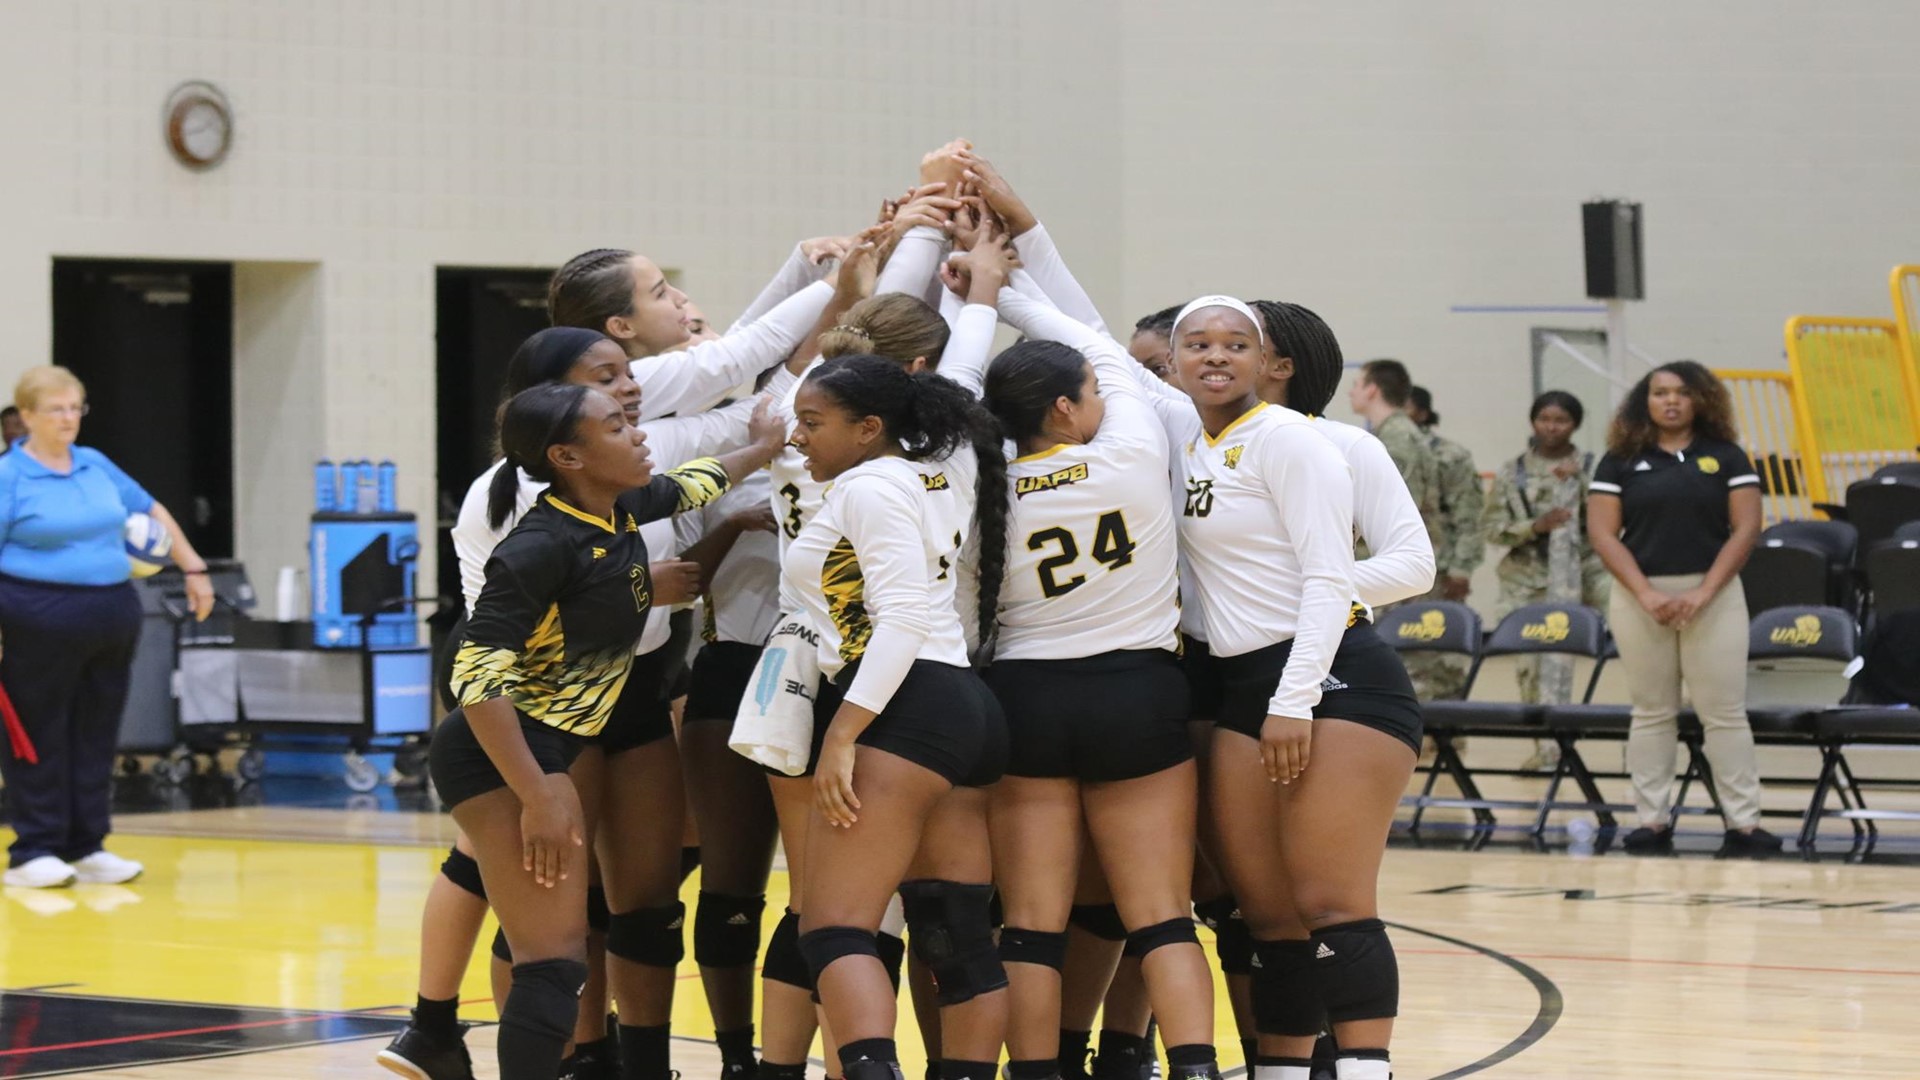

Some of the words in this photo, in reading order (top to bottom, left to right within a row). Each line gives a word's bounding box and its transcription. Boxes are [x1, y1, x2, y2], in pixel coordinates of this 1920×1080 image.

[1016, 463, 1088, 496] UAPB
[1026, 510, 1136, 598] 24
[630, 563, 650, 612] 2
